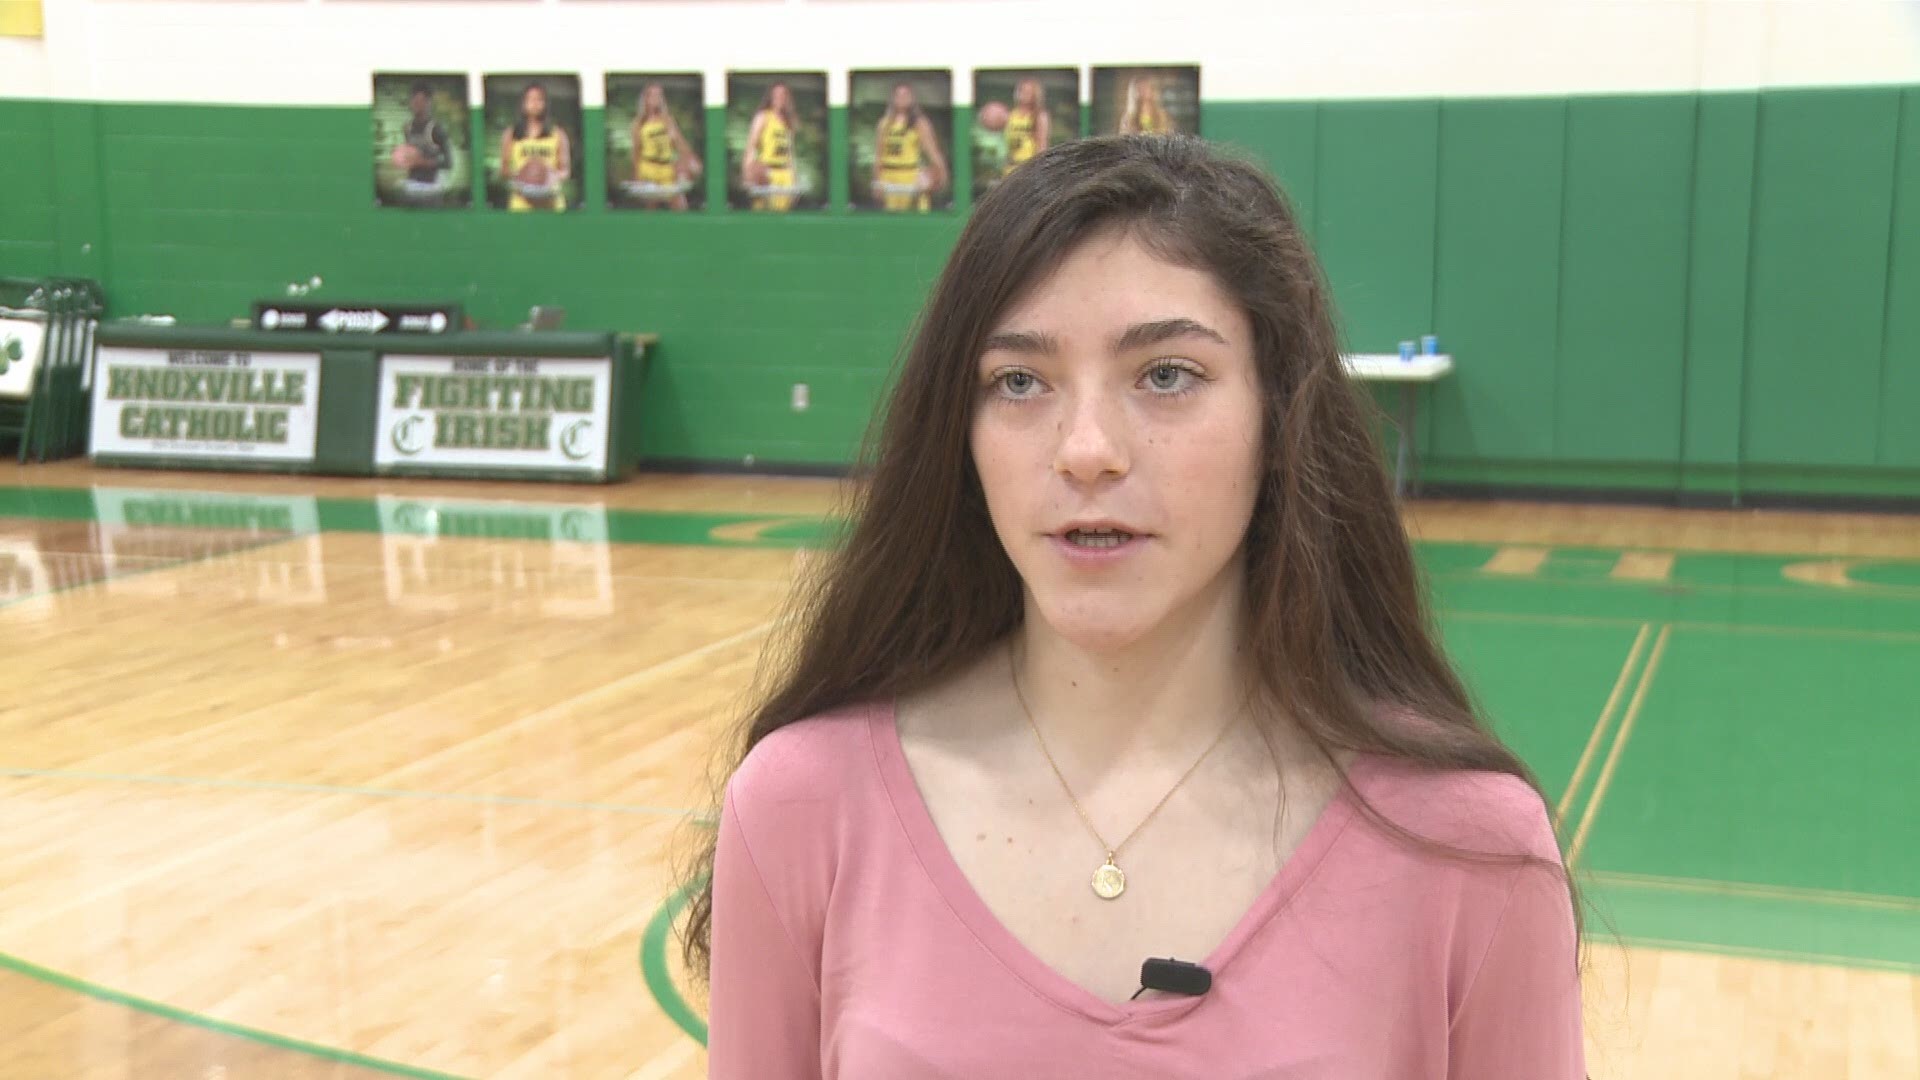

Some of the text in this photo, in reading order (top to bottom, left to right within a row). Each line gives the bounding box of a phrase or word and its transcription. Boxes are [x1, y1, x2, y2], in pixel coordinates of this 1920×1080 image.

[168, 351, 229, 365] WELCOME
[107, 365, 307, 405] KNOXVILLE
[394, 374, 594, 413] FIGHTING
[120, 404, 289, 443] CATHOLIC
[433, 412, 551, 450] IRISH
